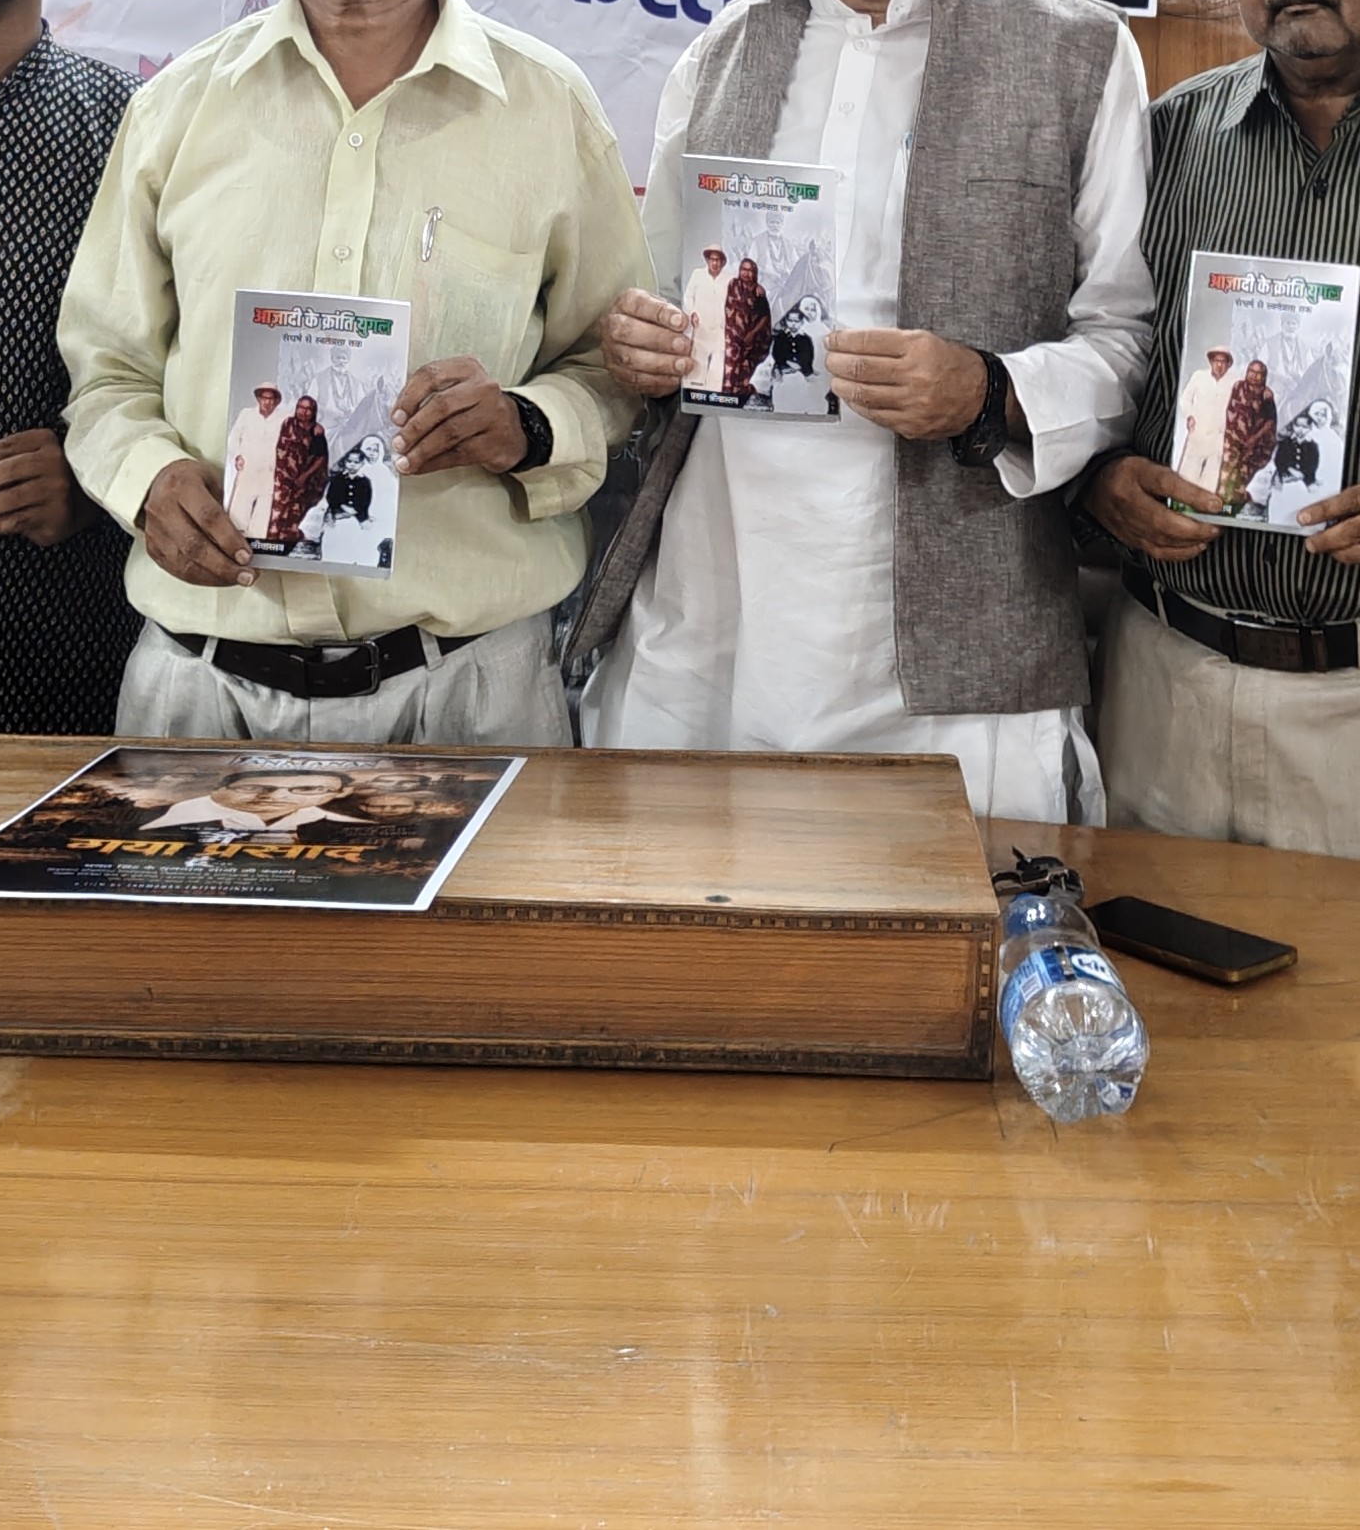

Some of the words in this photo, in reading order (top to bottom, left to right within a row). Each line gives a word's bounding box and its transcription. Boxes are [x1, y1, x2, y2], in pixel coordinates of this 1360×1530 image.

[741, 174, 756, 195] के
[1256, 272, 1271, 296] के
[304, 306, 319, 328] के
[320, 309, 356, 332] क्रांति
[355, 315, 394, 339] युगल
[66, 837, 192, 858] गया
[197, 841, 378, 864] प्रसाद
